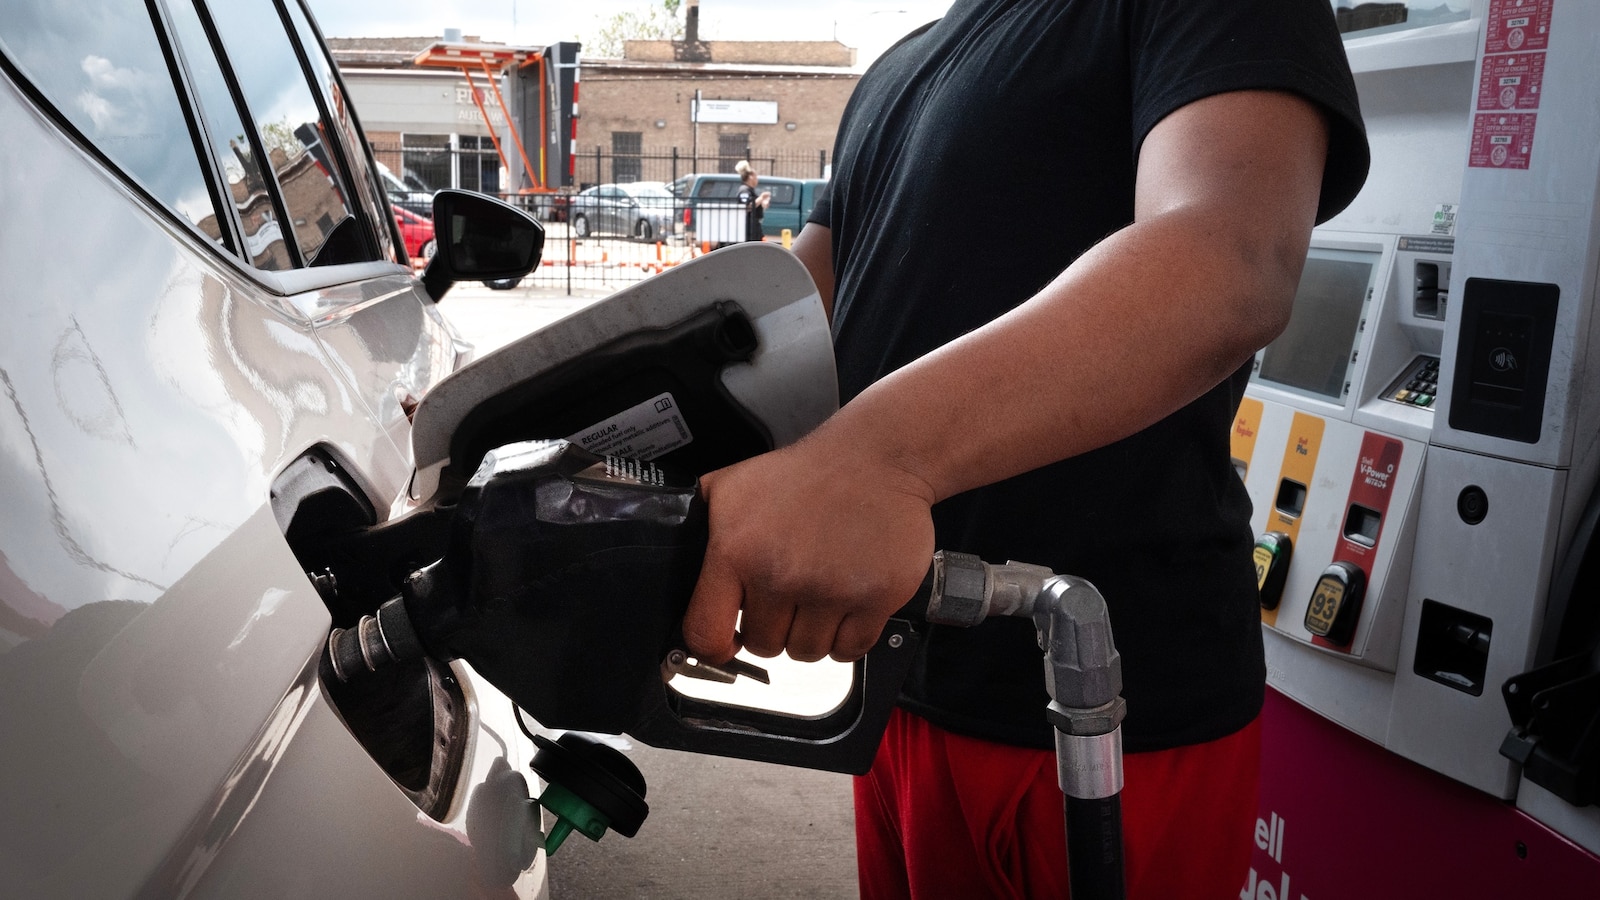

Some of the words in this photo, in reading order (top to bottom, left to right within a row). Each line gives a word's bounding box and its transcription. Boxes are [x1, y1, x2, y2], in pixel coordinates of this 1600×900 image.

[1442, 204, 1452, 212] TOP
[1444, 212, 1455, 220] TIER
[582, 425, 618, 444] REGULAR
[611, 429, 624, 439] fuel
[624, 426, 636, 435] only
[1296, 444, 1308, 456] Plus
[1361, 456, 1374, 466] Shell
[1360, 463, 1390, 481] V-Power
[1312, 593, 1337, 619] 93
